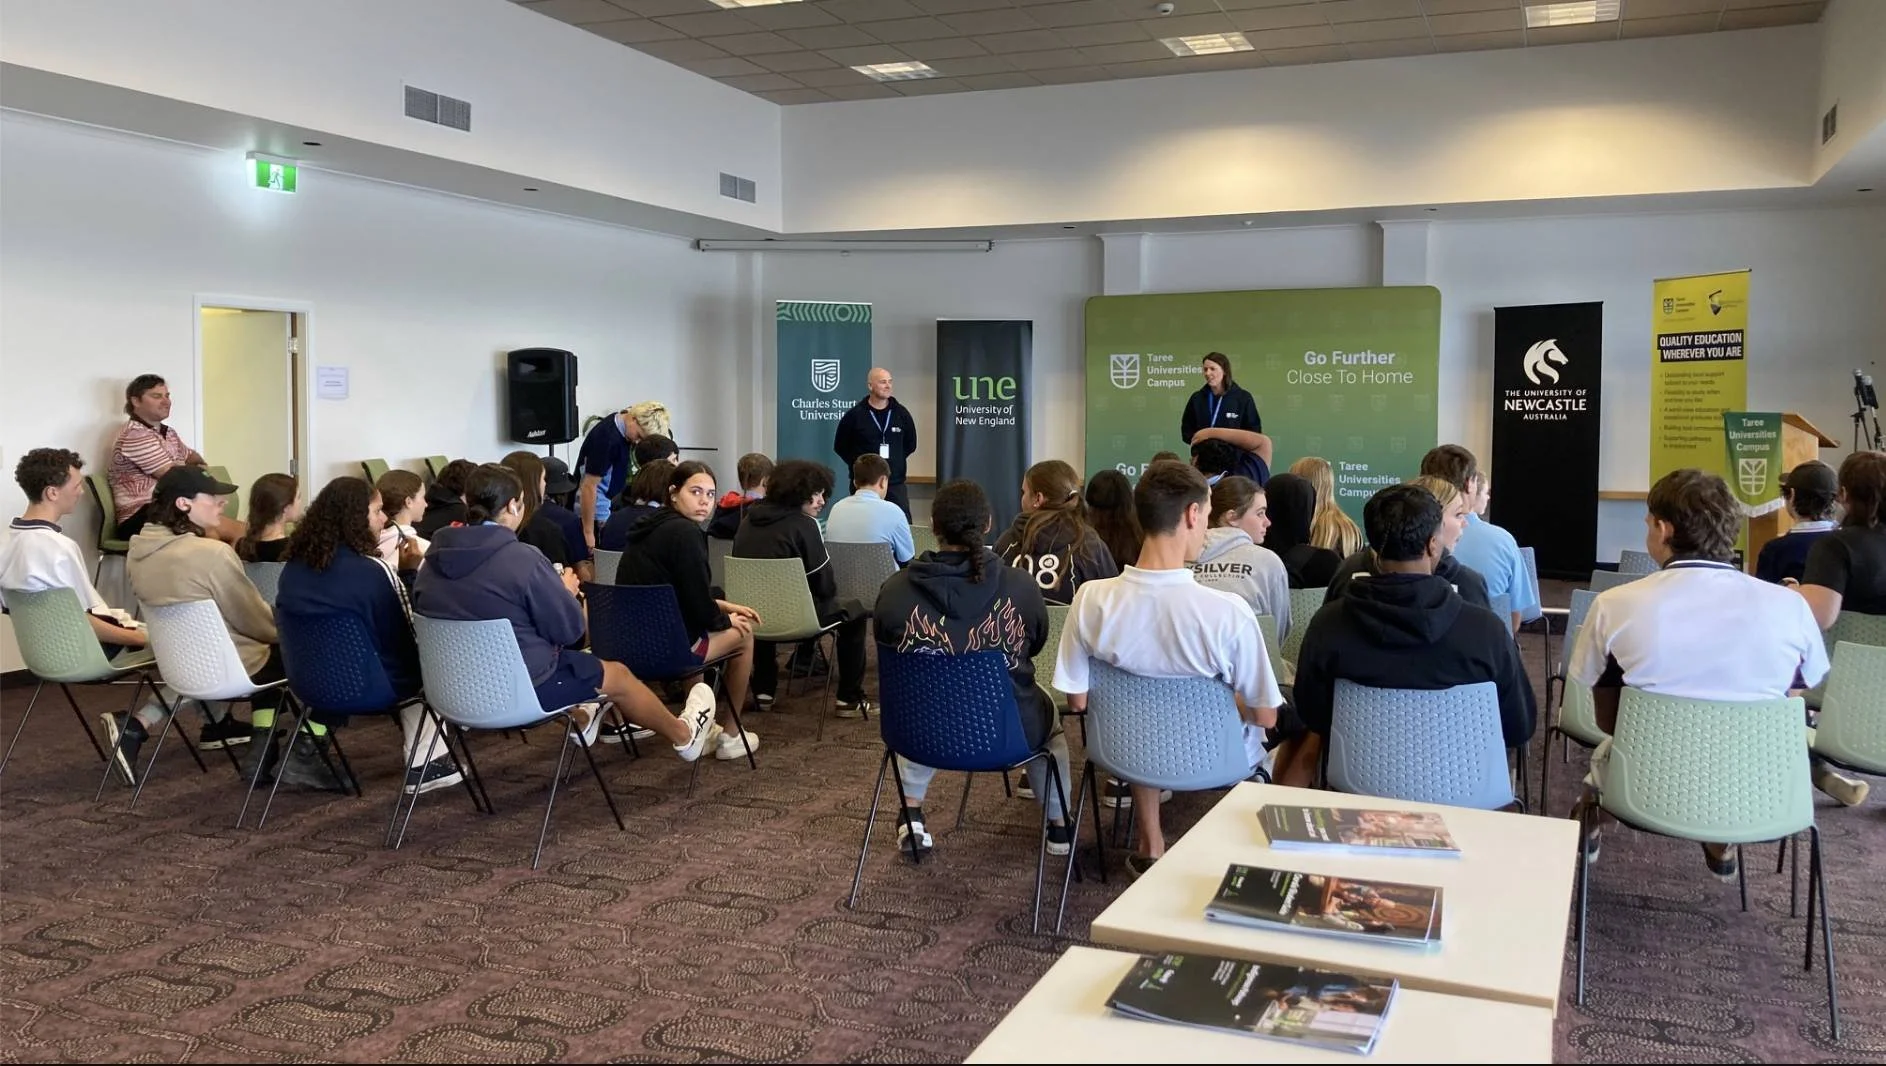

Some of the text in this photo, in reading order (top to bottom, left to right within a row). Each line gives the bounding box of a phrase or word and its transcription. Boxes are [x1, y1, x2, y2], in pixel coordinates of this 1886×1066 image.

[1660, 332, 1742, 347] QUALITY EDUCATION
[1147, 353, 1173, 362] Taree
[1304, 350, 1395, 365] Go Further
[1663, 346, 1742, 360] WHEREVER YOU ARE
[1287, 369, 1413, 384] Close To Home
[952, 376, 1016, 400] une
[1147, 378, 1185, 388] Campus
[1524, 389, 1572, 397] UNIVERSITY
[791, 398, 830, 408] Charles
[1504, 399, 1587, 411] NEWCASTLE
[955, 405, 1014, 415] University of
[955, 416, 1016, 427] New England
[1523, 413, 1568, 421] AUSTRALIA
[1741, 418, 1765, 427] Taree
[1115, 463, 1137, 476] Go
[1339, 461, 1369, 471] Taree
[1339, 474, 1401, 485] Universities
[1339, 488, 1376, 499] Campu
